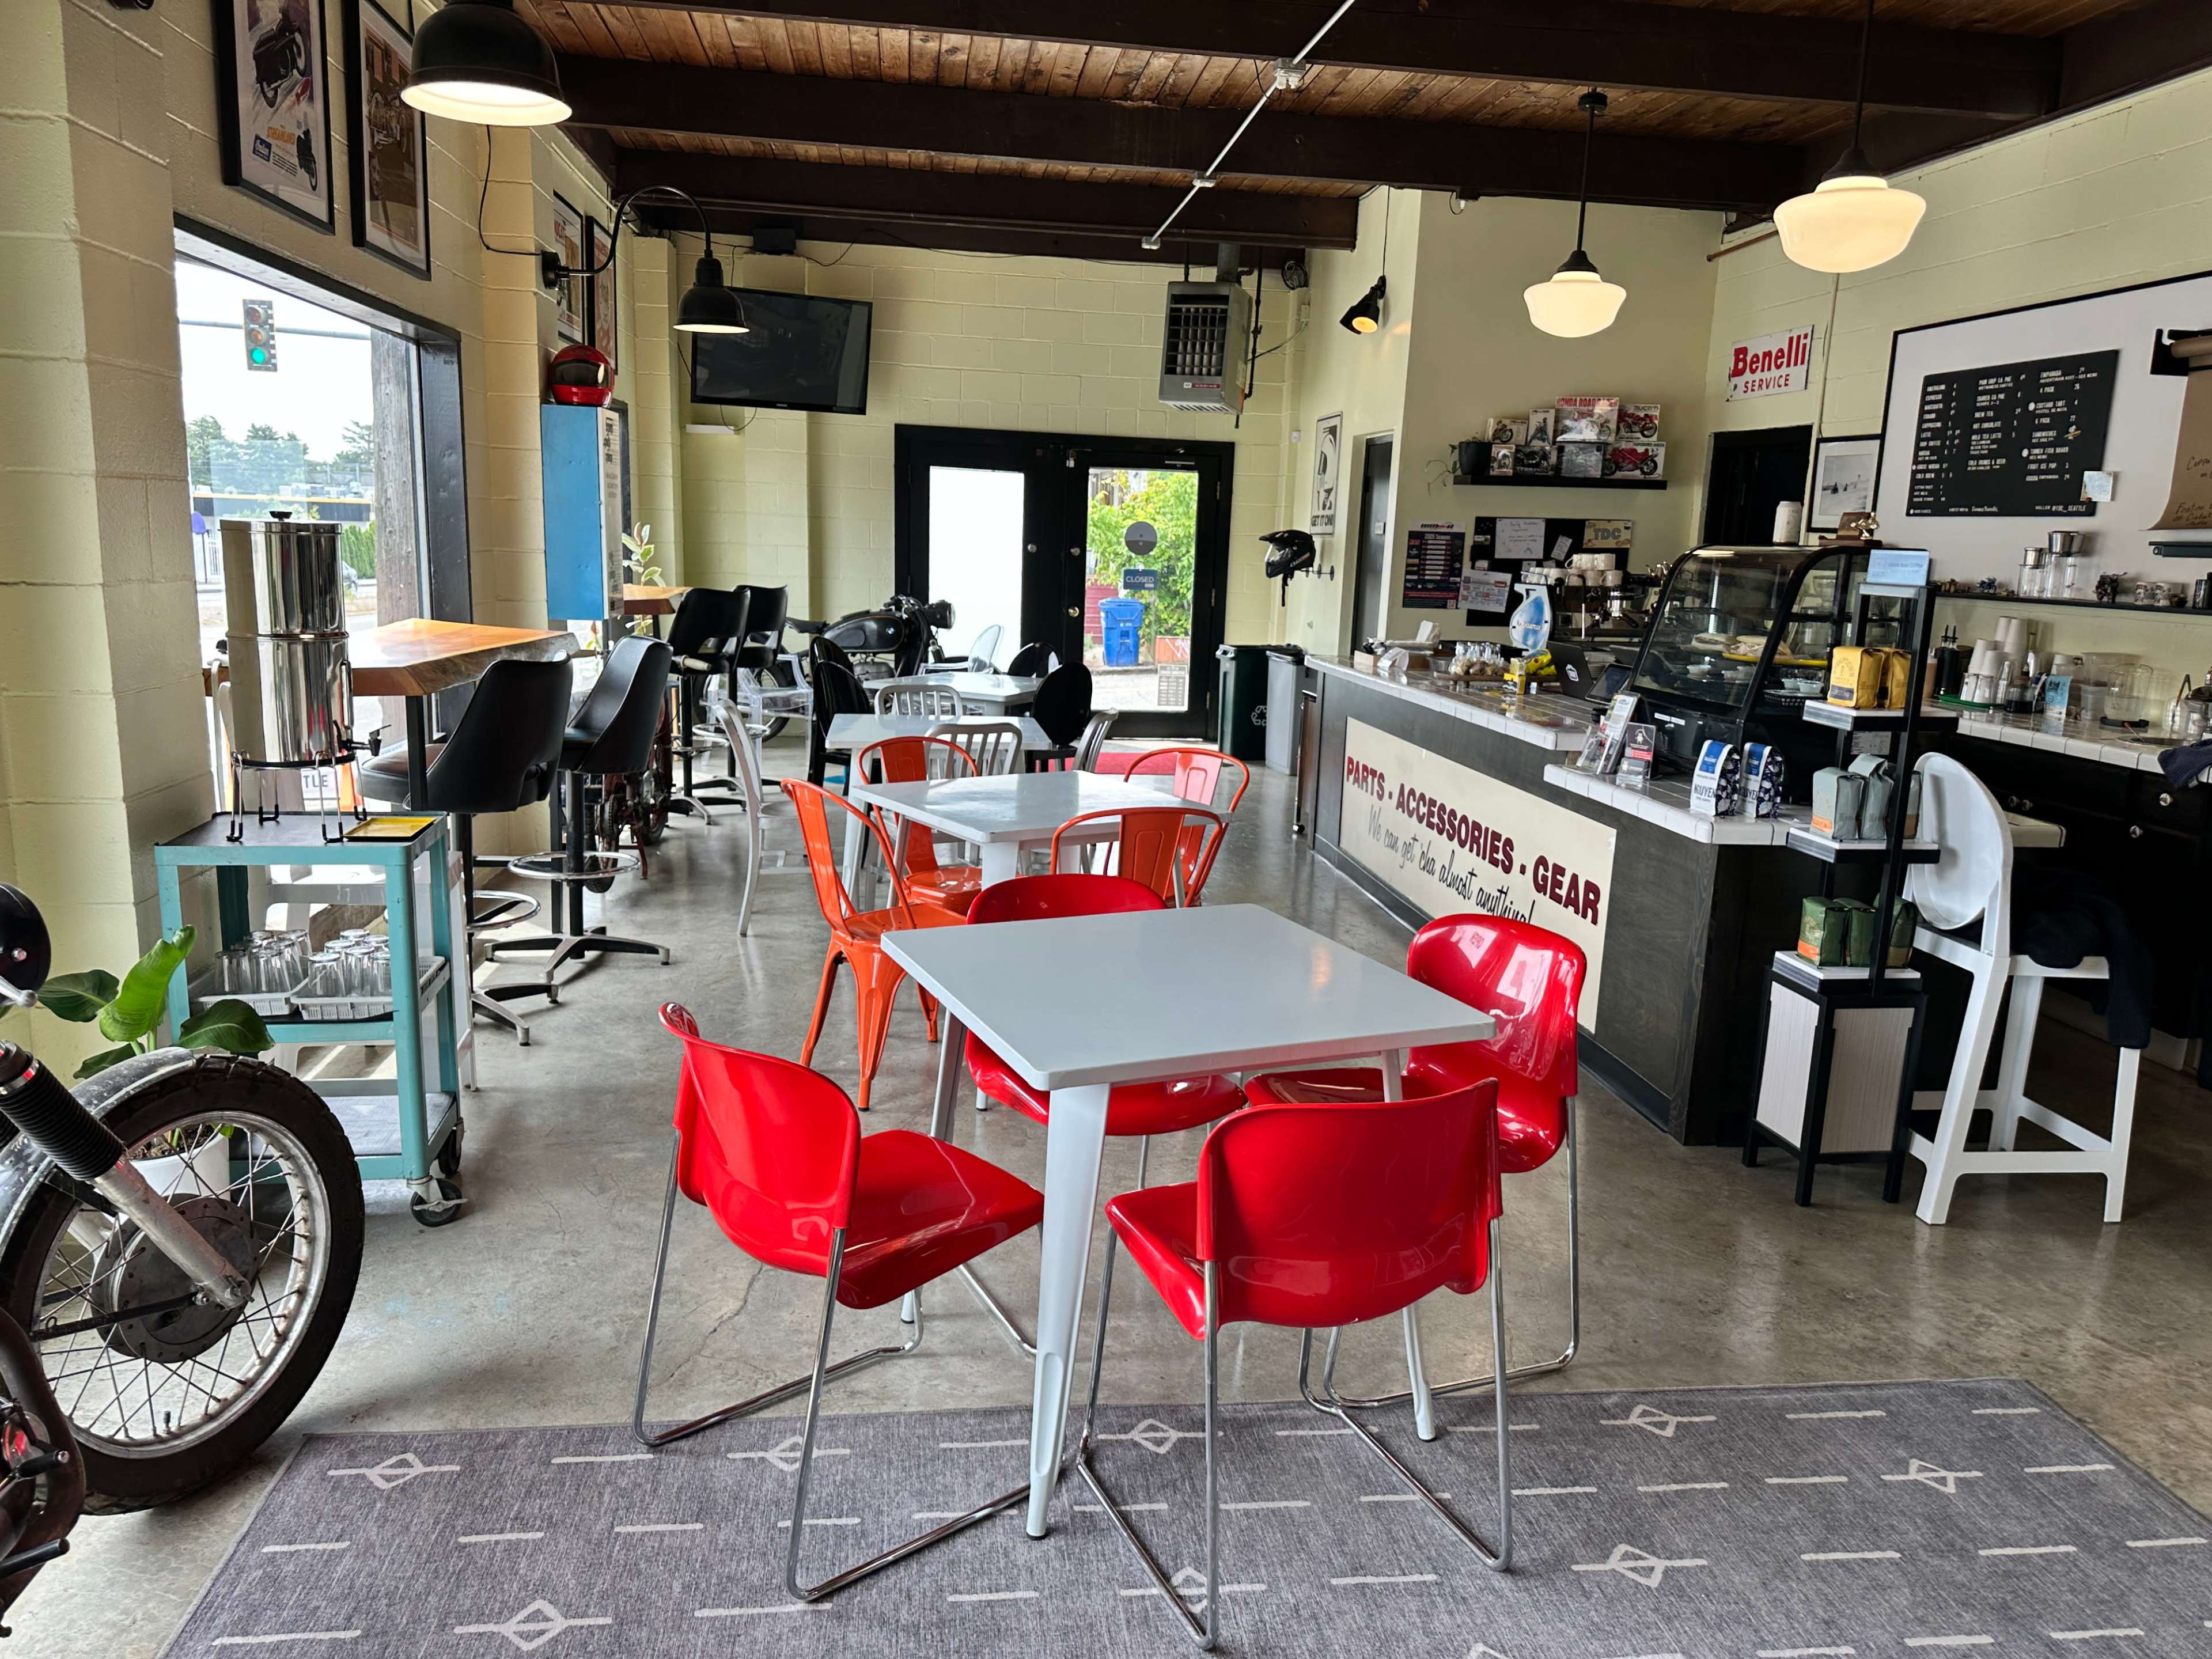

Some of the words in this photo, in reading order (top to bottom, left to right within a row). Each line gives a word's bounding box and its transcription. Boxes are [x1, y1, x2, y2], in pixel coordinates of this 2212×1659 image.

[1731, 332, 1809, 378] Benelli
[1743, 374, 1790, 393] SERVICE
[1557, 397, 1577, 407] HONDA
[1311, 515, 1320, 527] GET
[1594, 528, 1622, 540] TDC
[1346, 756, 1385, 801] PARTS
[1396, 783, 1514, 875] ACCESSORIES
[1533, 855, 1601, 926] GEAR
[1368, 804, 1382, 842] We
[1384, 828, 1399, 854] can
[1399, 834, 1419, 869] get
[1439, 849, 1478, 900] almost
